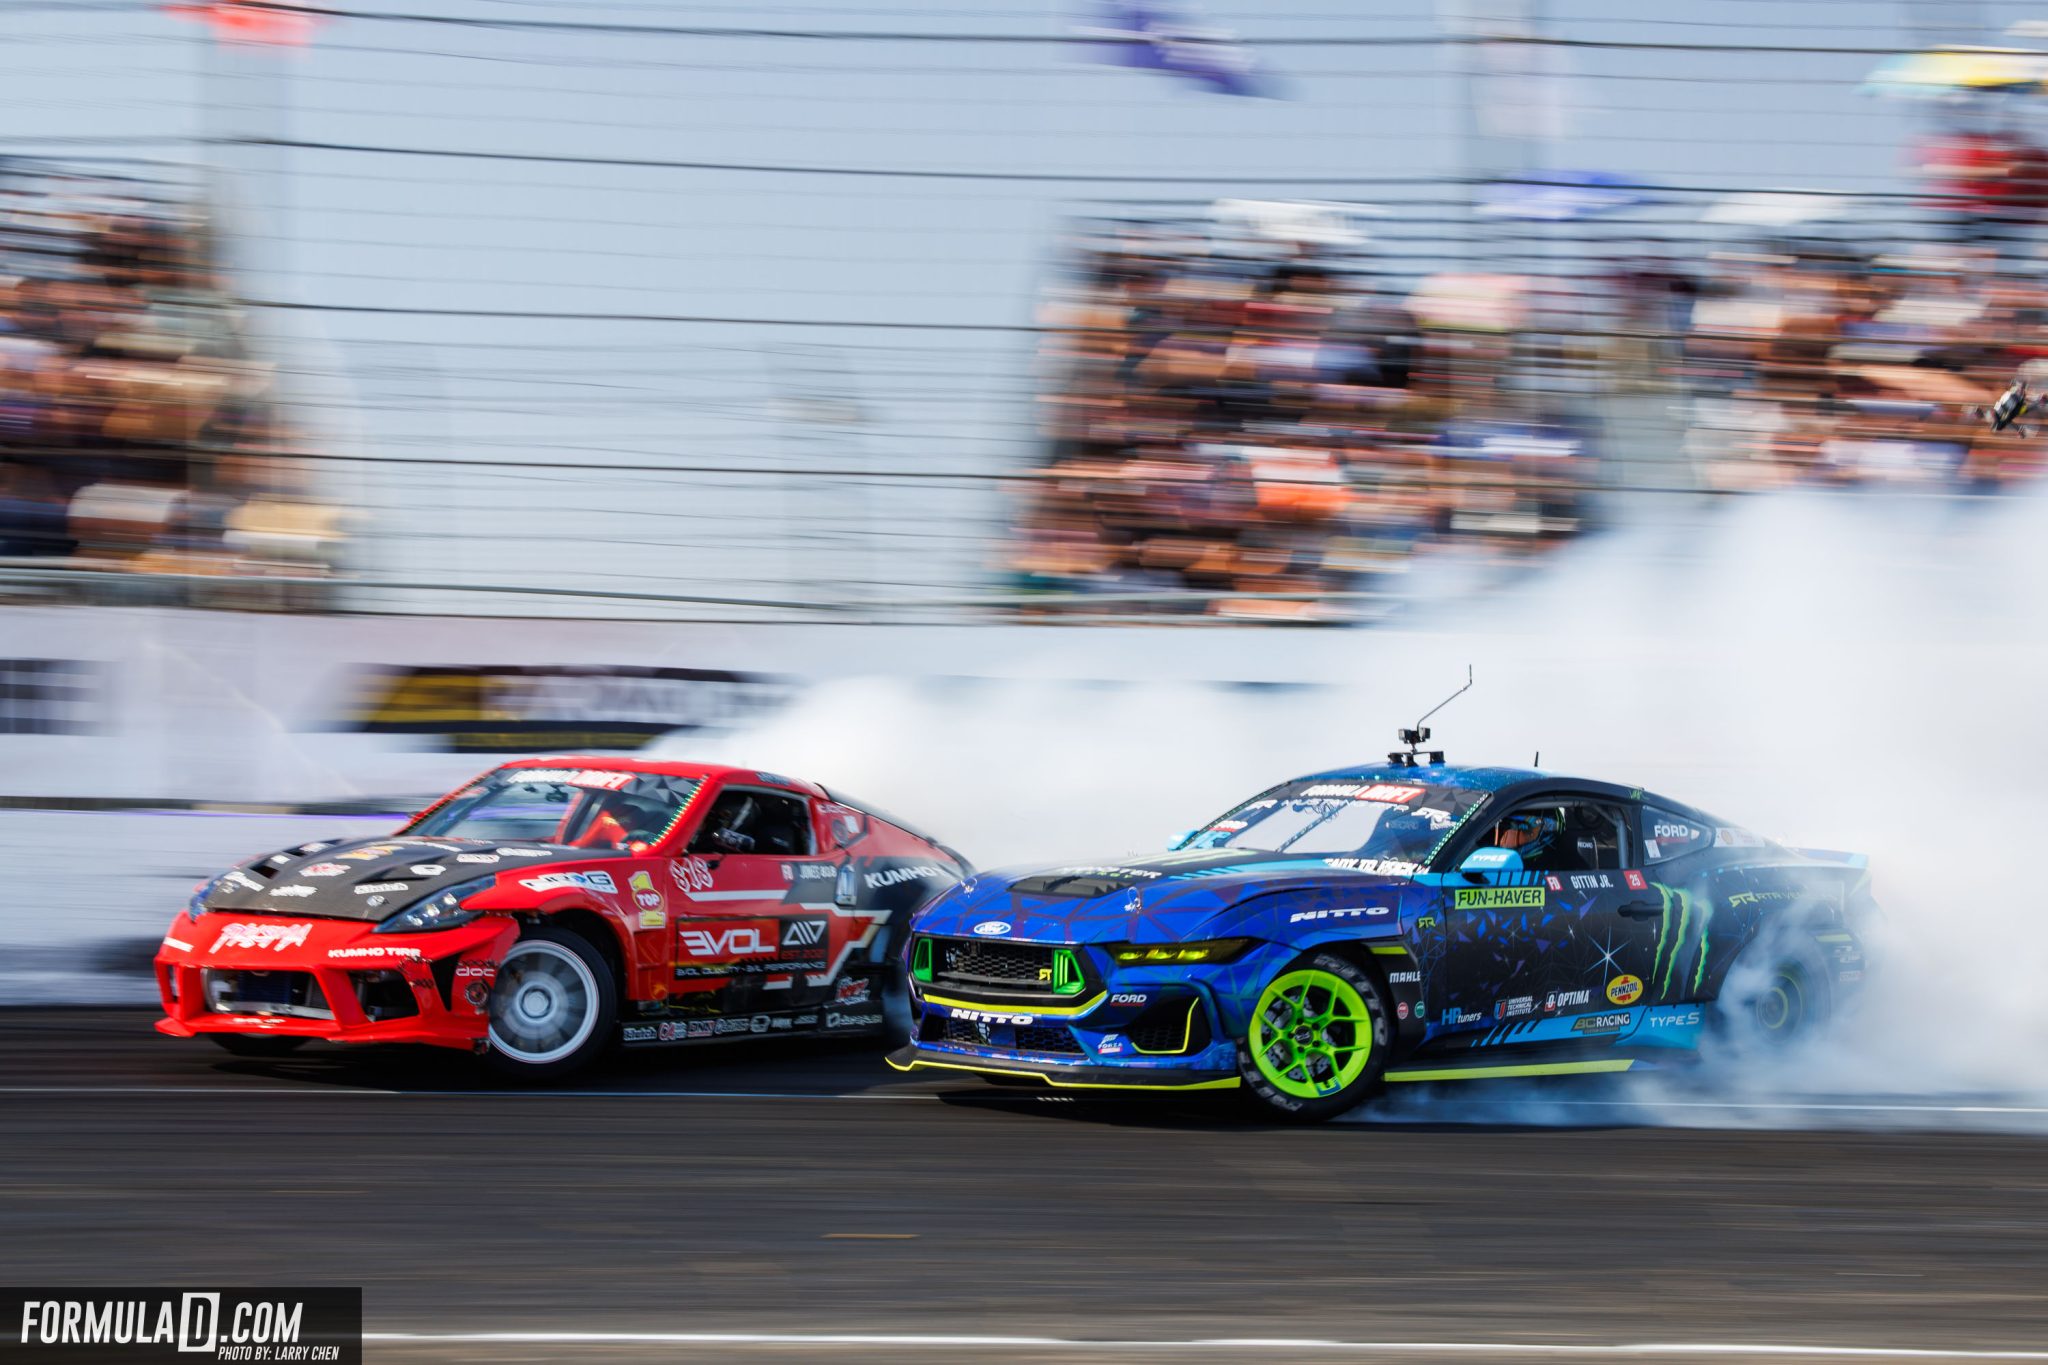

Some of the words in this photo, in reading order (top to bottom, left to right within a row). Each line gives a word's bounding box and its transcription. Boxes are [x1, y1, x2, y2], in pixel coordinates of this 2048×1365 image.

[1654, 825, 1689, 837] FORD
[863, 866, 937, 889] KUMHO
[1549, 876, 1561, 890] FD
[1570, 874, 1599, 889] GITTIN
[1600, 873, 1614, 888] JR.
[1629, 874, 1641, 887] 25
[636, 893, 660, 906] TOP
[1457, 889, 1542, 906] FUN-HAVER
[1290, 906, 1389, 923] NITTO
[328, 948, 385, 958] KUMHO
[1389, 971, 1421, 984] MAHLE
[1111, 994, 1147, 1003] FORD
[1507, 996, 1533, 1005] UNIVERSAL
[1557, 990, 1589, 1007] OPTIMA
[1506, 1008, 1531, 1016] INSTITUTE
[1507, 1002, 1532, 1010] TECHNICAL
[951, 1008, 1034, 1025] NITTO
[1442, 1007, 1462, 1025] HP
[1457, 1012, 1482, 1023] tuners
[1596, 1014, 1630, 1028] RACING
